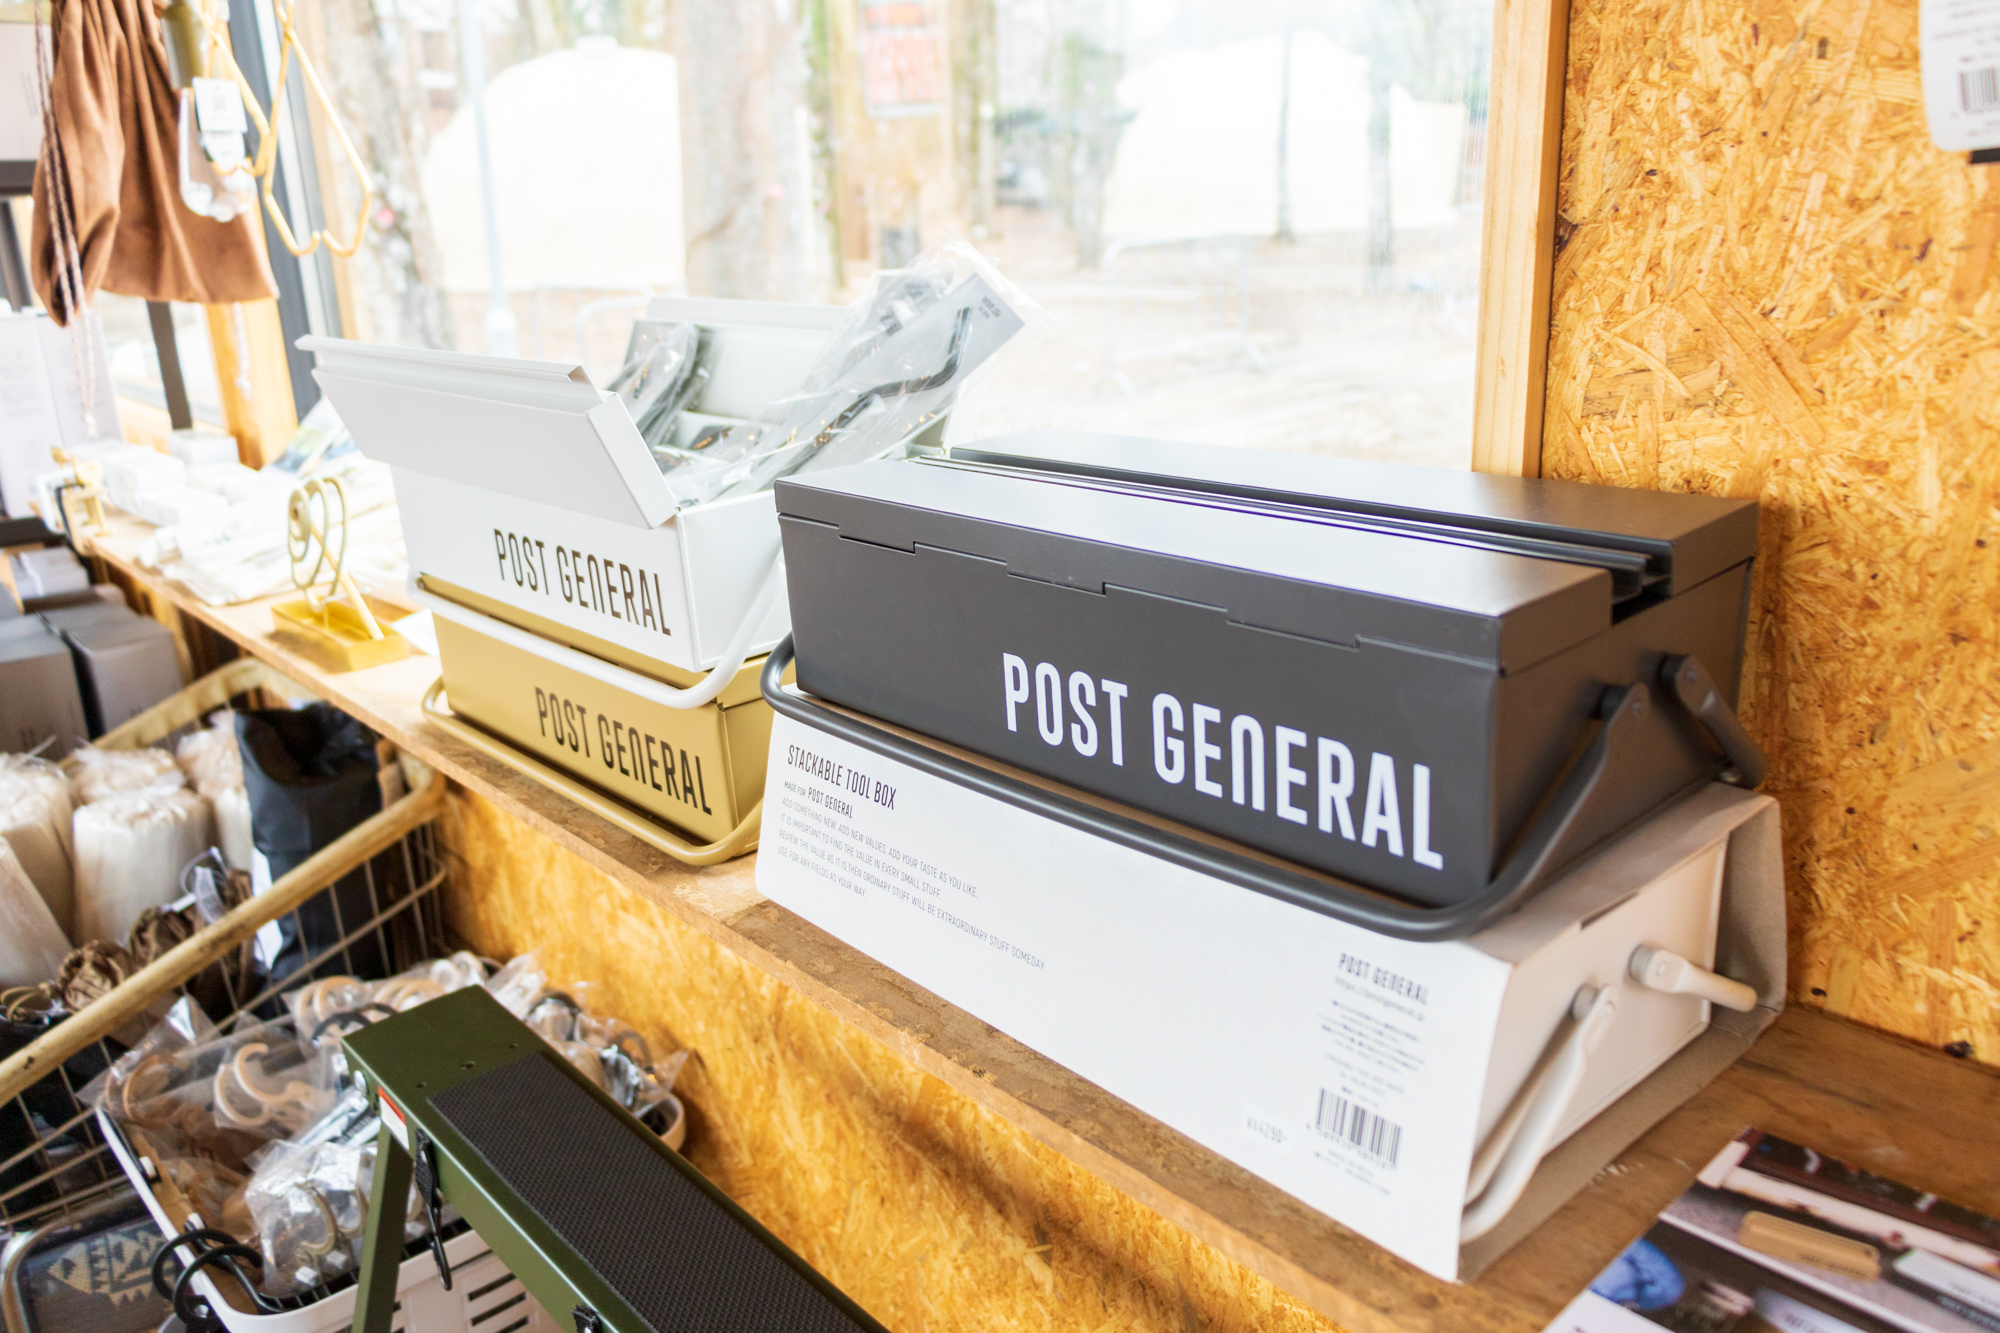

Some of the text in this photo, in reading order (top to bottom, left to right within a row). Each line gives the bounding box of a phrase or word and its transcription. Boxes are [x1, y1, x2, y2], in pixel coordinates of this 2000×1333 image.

[493, 528, 672, 637] POST GENERAL
[534, 687, 712, 816] POST GENERAL
[788, 744, 897, 810] STACKABLE TOOL BOX
[1003, 652, 1443, 870] POST GENERAL
[784, 780, 853, 819] MADE FOR POST GENERAL
[778, 845, 788, 858] USE
[789, 850, 799, 863] FOR
[800, 857, 811, 869] ANY
[812, 862, 829, 879] FIELDS
[830, 872, 838, 883] AS
[838, 876, 852, 891] YOUR
[780, 813, 786, 822] IT
[786, 816, 792, 825] IS
[793, 819, 821, 840] IMPORTANT
[822, 833, 829, 844] TO
[830, 837, 843, 850] FIND
[844, 843, 855, 856] THE
[856, 850, 873, 866] VALUE
[874, 858, 881, 869] IN
[881, 862, 900, 878] EVERY
[901, 872, 920, 889] SMALL
[782, 797, 793, 809] ADD
[793, 802, 822, 823] SOMETHING
[838, 824, 850, 836] ADD
[851, 830, 865, 842] NEW
[889, 848, 901, 860] ADD
[902, 853, 918, 868] YOUR
[920, 861, 938, 878] TASTE
[939, 871, 948, 883] AS
[949, 875, 962, 889] YOU
[779, 829, 798, 845] REVIEW
[800, 838, 809, 852] THE
[810, 844, 826, 860] VALUE
[827, 853, 834, 864] AS
[835, 857, 841, 867] IT
[863, 871, 891, 892] ORDINARY
[892, 886, 910, 902] STUFF
[911, 895, 926, 911] WILL
[927, 903, 936, 916] BE
[937, 908, 989, 942] EXTRAORDINARY
[989, 935, 1010, 953] STUFF
[1338, 952, 1429, 1006] POST GENERAL
